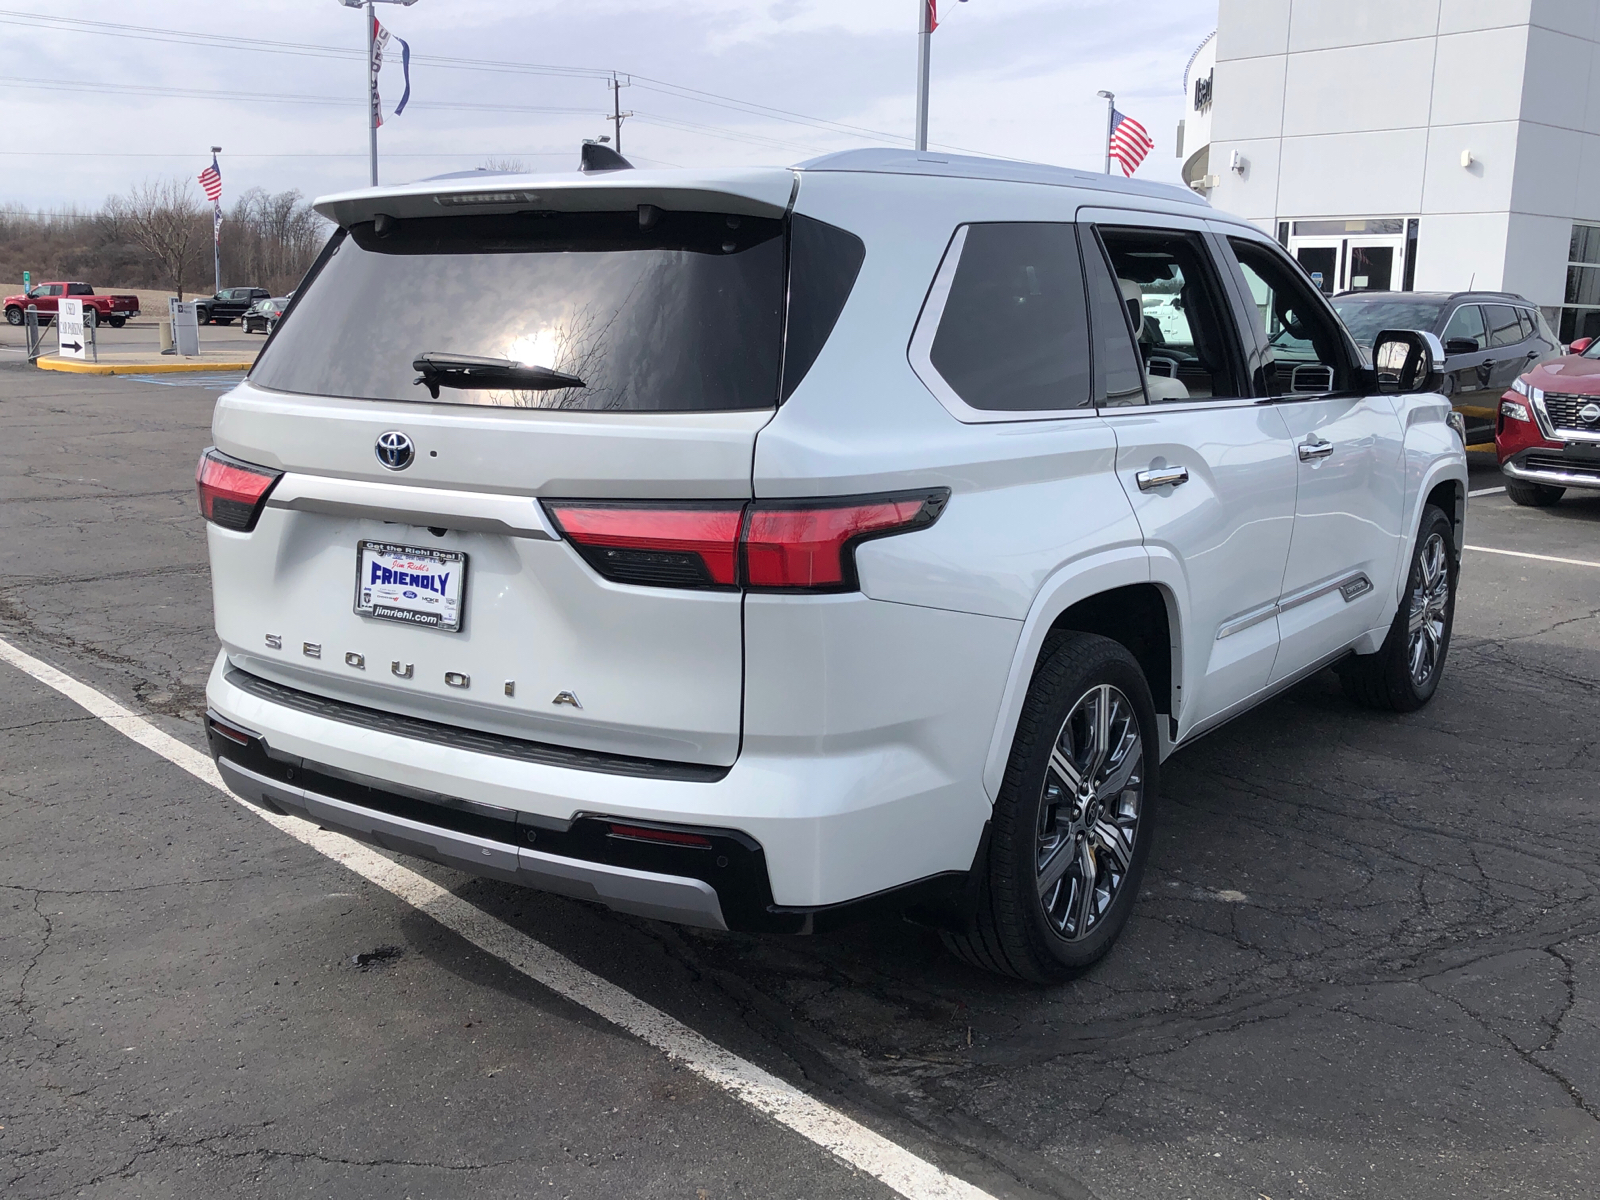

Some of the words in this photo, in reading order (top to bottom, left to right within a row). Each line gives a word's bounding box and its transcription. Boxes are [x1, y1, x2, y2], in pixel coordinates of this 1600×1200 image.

[366, 542, 384, 550] Get
[386, 545, 403, 553] the
[405, 547, 430, 556] Riehl
[432, 551, 456, 560] Deal
[391, 560, 405, 569] Jim
[407, 562, 429, 572] Riehl's
[370, 560, 450, 597] FRIENDLY
[374, 607, 438, 624] jimriehl.com
[265, 632, 583, 710] SEQUOIA
